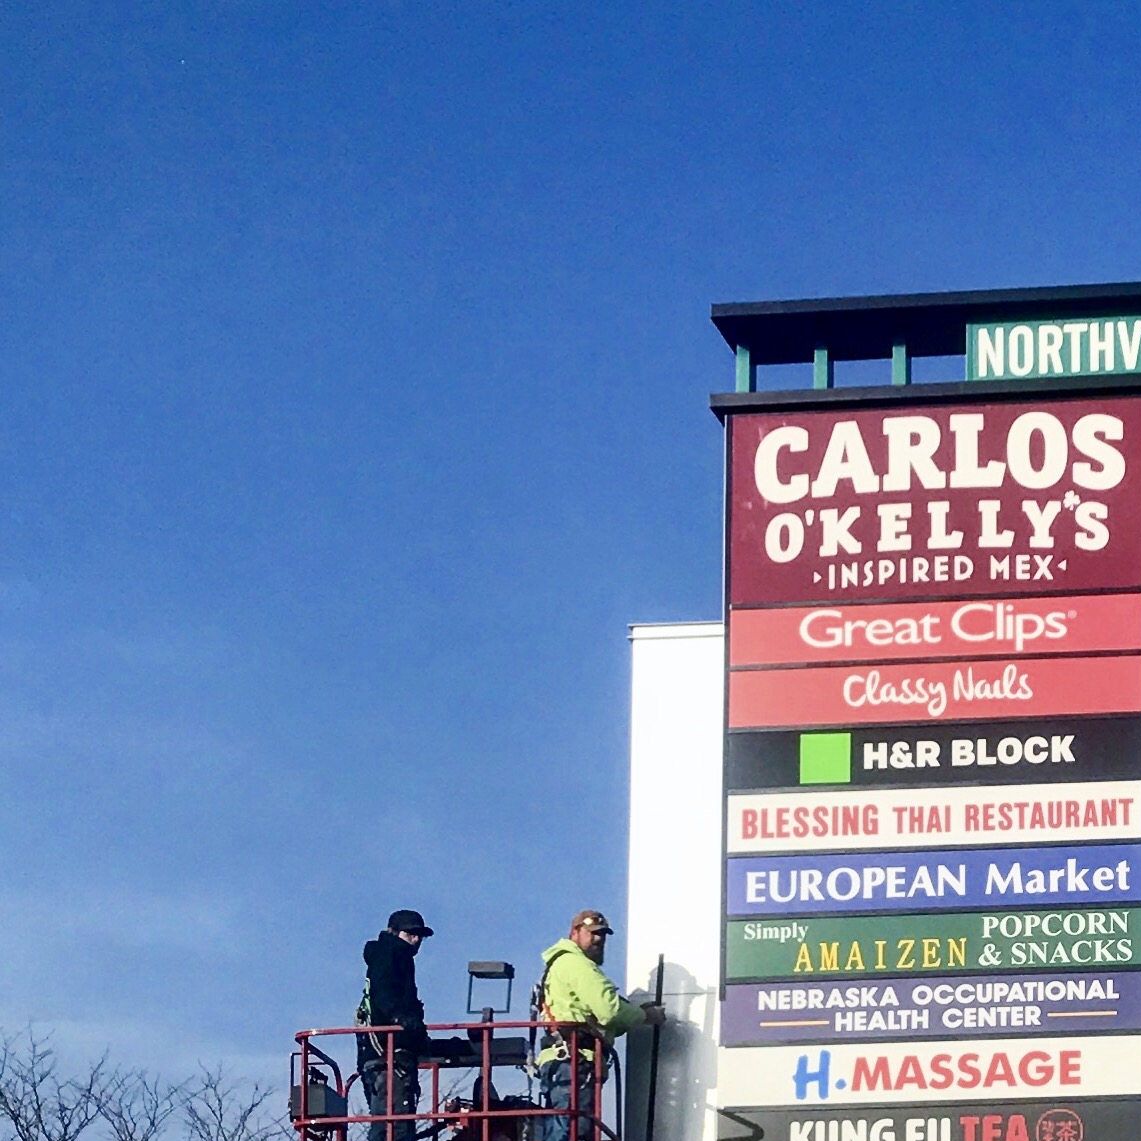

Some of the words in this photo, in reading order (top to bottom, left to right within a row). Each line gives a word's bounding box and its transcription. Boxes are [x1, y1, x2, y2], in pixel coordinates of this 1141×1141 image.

[754, 411, 1126, 503] CARLOS
[764, 490, 1110, 563] O'KELLY'S
[828, 554, 974, 590] INSPIRED
[990, 555, 1055, 581] MEX
[799, 609, 942, 648] Great
[951, 602, 1068, 652] Clips
[843, 670, 947, 717] Classy
[953, 664, 1034, 701] Nails
[863, 740, 941, 770] H&R
[951, 735, 1076, 767] BLOCK
[741, 804, 879, 840] BLESSING
[892, 804, 951, 834] THAI
[965, 798, 1134, 832] RESTAURANT
[746, 864, 967, 903] EUROPEAN
[985, 858, 1131, 895] Market
[743, 923, 809, 943] Simply
[981, 911, 1130, 939] POPCORN
[793, 938, 967, 972] AMAIZEN
[978, 947, 1002, 967] &
[1011, 938, 1133, 965] SNACKS
[757, 985, 899, 1011] NEBRASKA
[911, 980, 1120, 1005] OCCUPATIONAL
[834, 1012, 930, 1032] HEALTH
[942, 1006, 1042, 1027] CENTER
